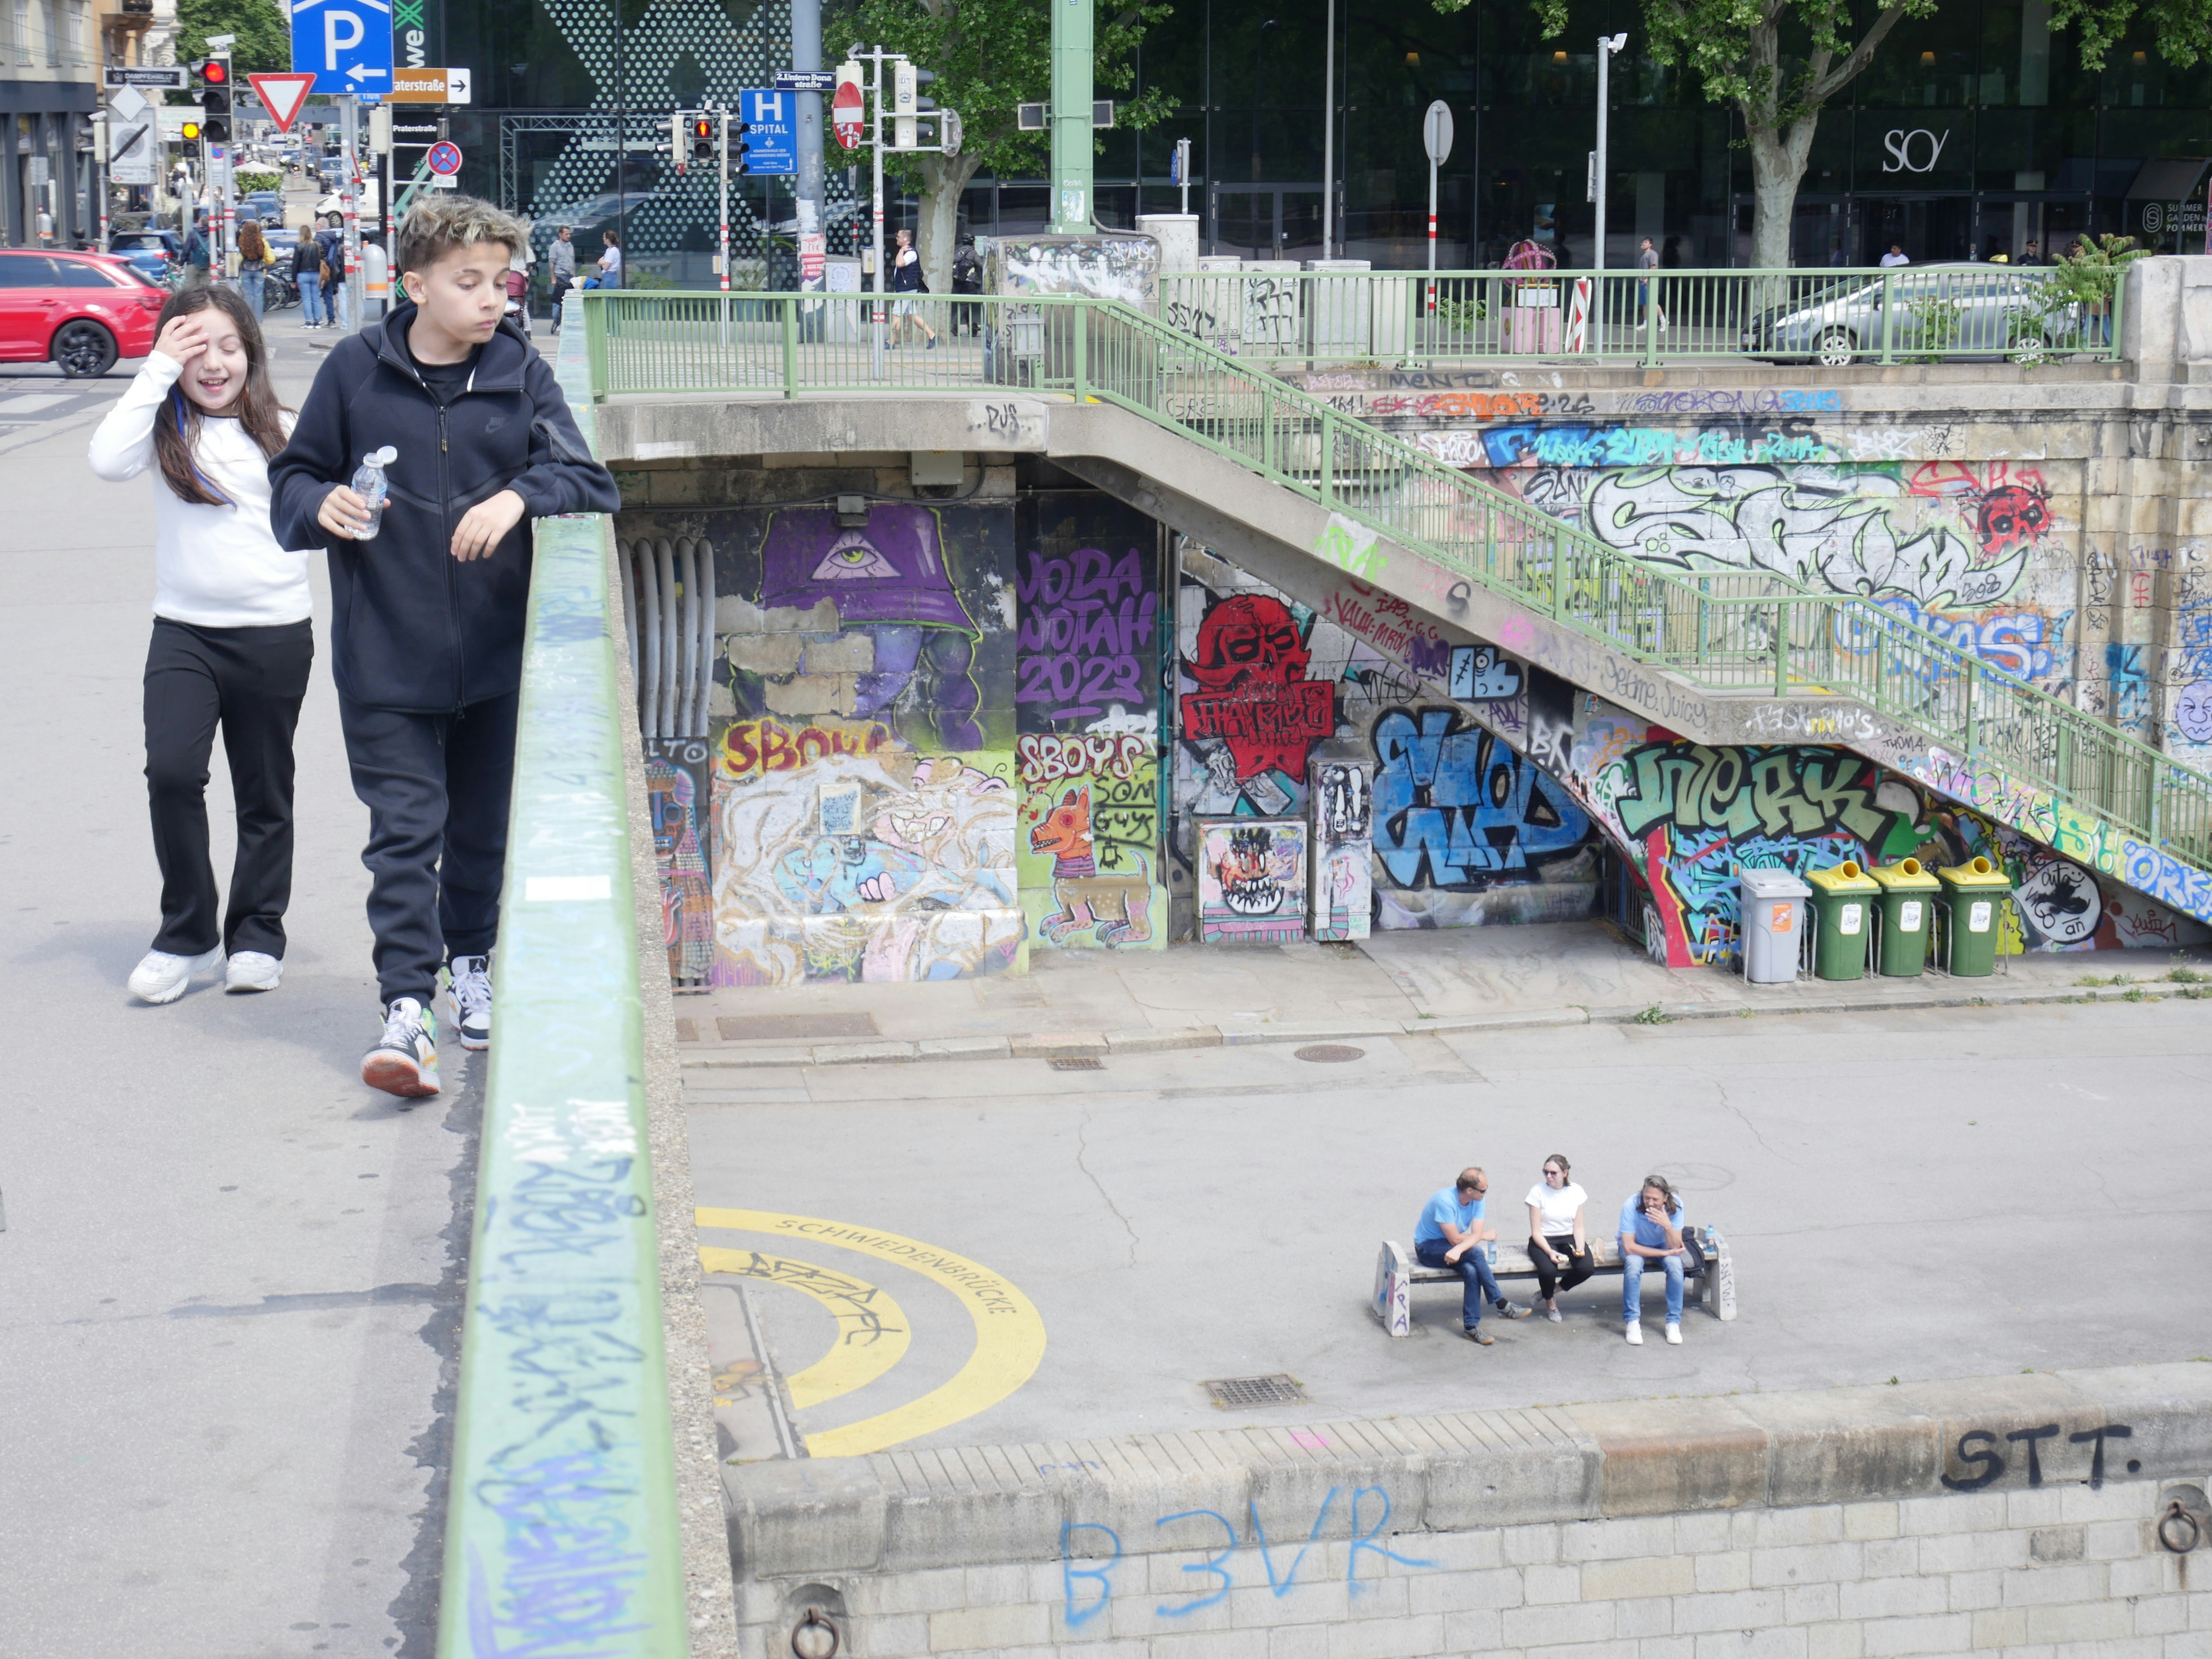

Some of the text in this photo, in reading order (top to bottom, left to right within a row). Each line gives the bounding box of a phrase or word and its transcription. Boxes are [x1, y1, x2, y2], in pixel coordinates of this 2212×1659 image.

[324, 10, 364, 70] P
[754, 92, 782, 121] H
[750, 124, 789, 134] SPITAL
[2167, 213, 2200, 221] GADEN
[775, 1220, 1017, 1315] SCHWEDENBRÜCKE
